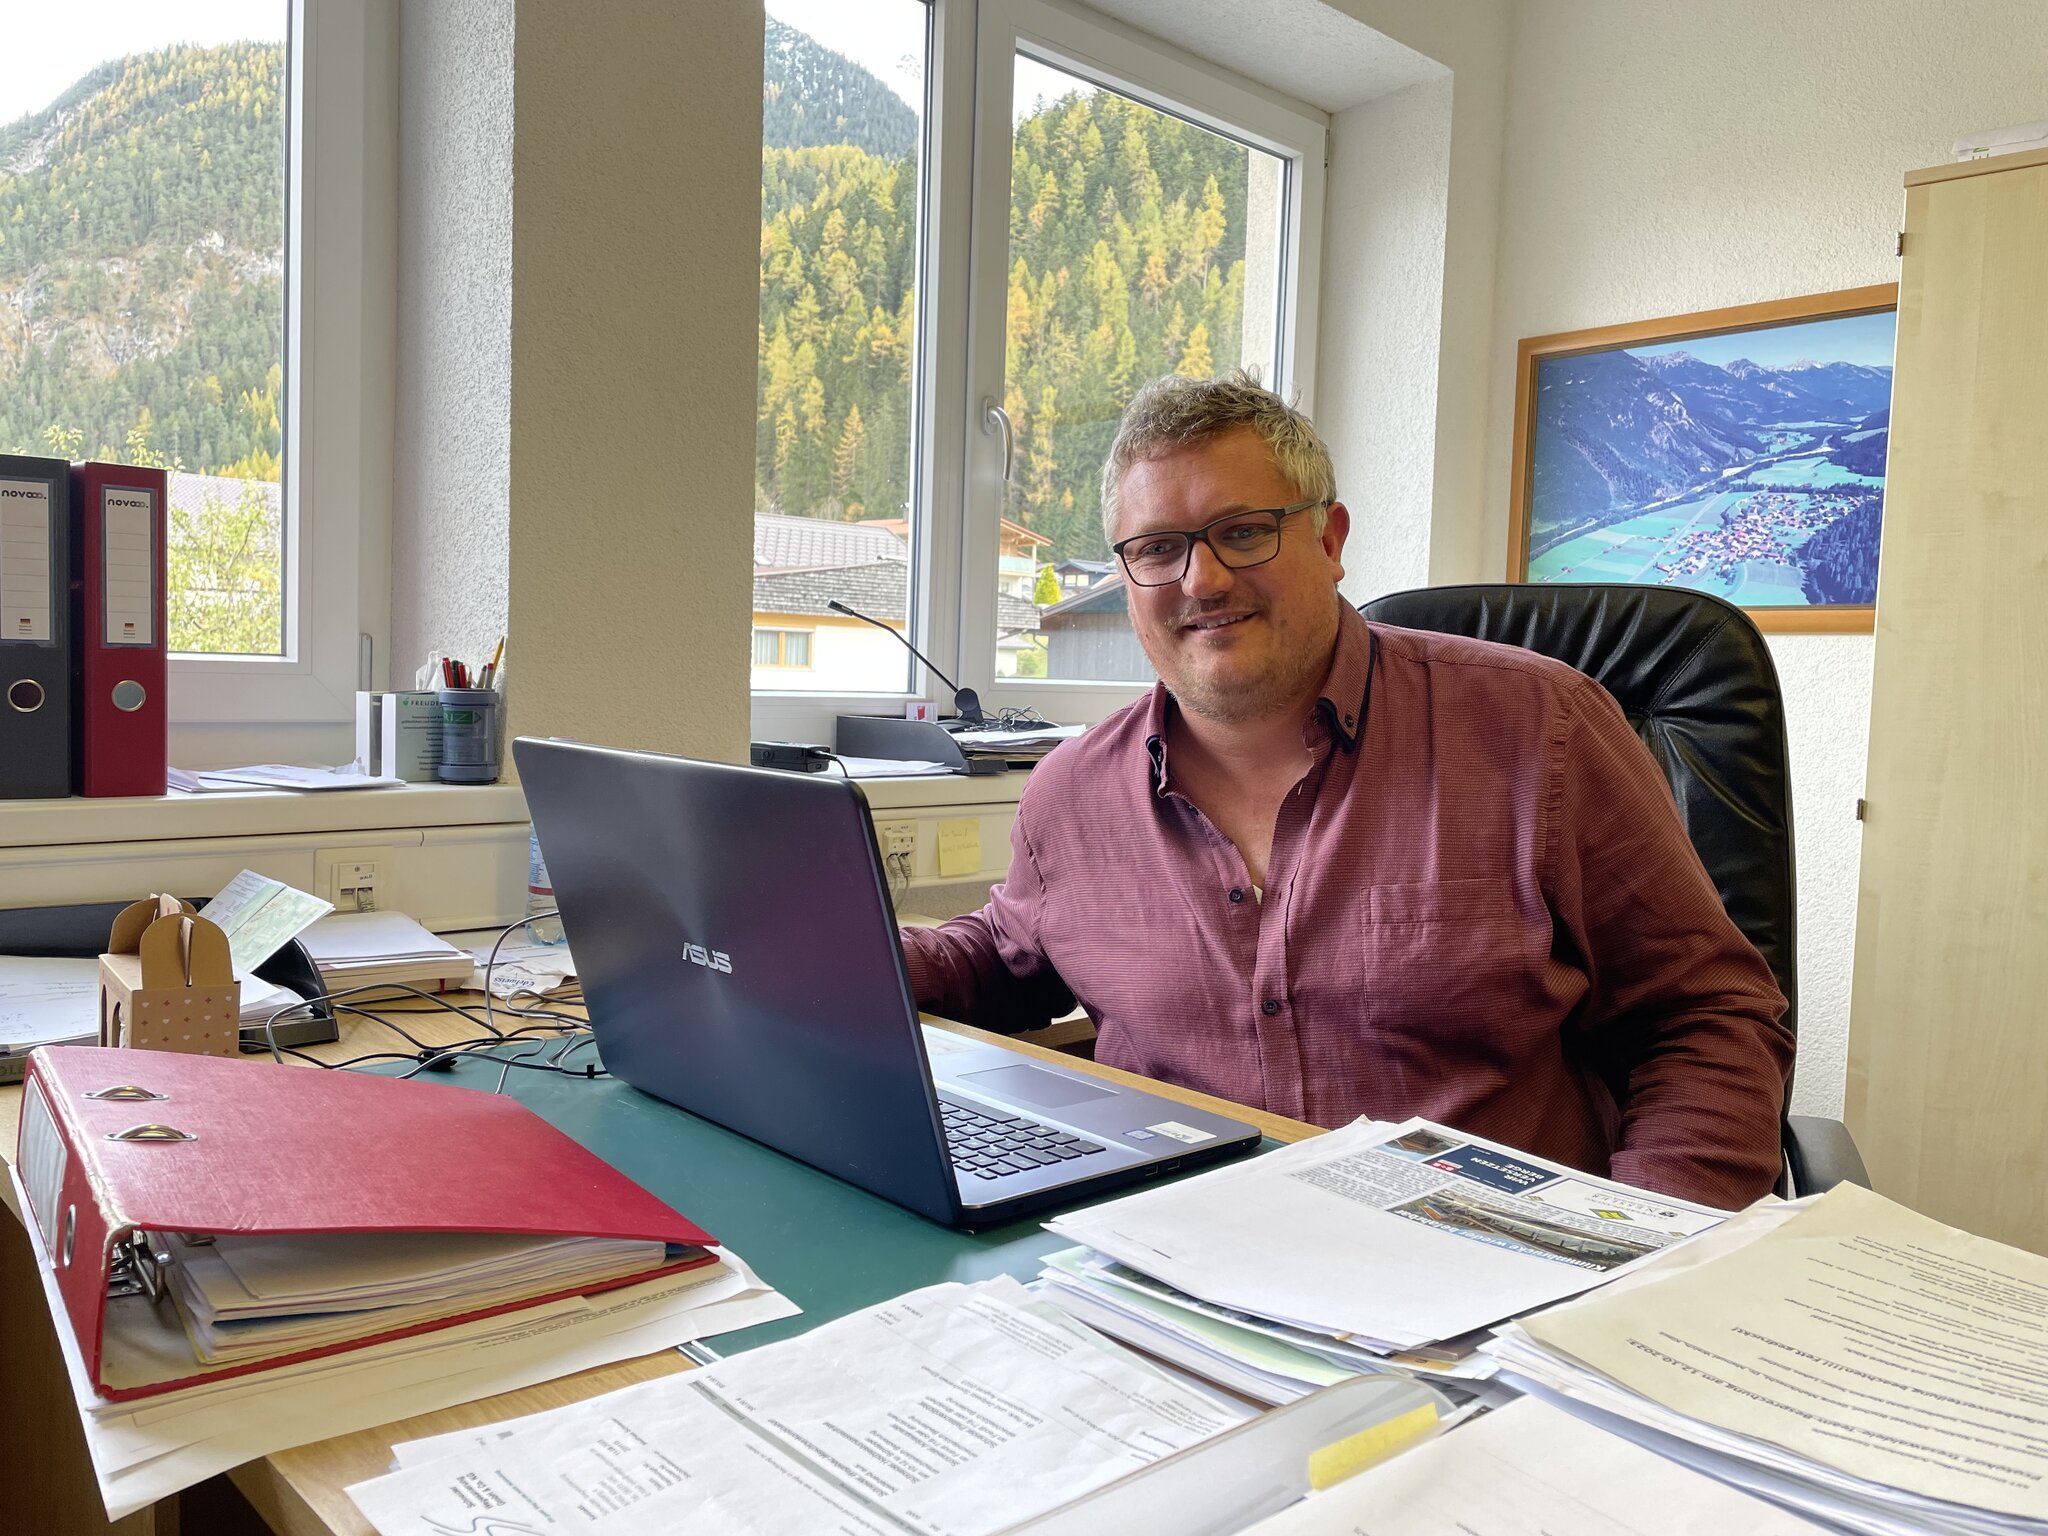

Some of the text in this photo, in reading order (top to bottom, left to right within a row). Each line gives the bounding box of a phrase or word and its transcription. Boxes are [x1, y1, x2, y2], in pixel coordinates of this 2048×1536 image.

[682, 942, 733, 974] ASUS
[494, 976, 535, 987] Edelweiss
[1470, 1157, 1535, 1182] VERSETZEN
[1505, 1163, 1544, 1179] BERGE
[1504, 1174, 1528, 1185] WIR
[1394, 1208, 1458, 1235] befahrbar
[1461, 1230, 1506, 1248] wieder
